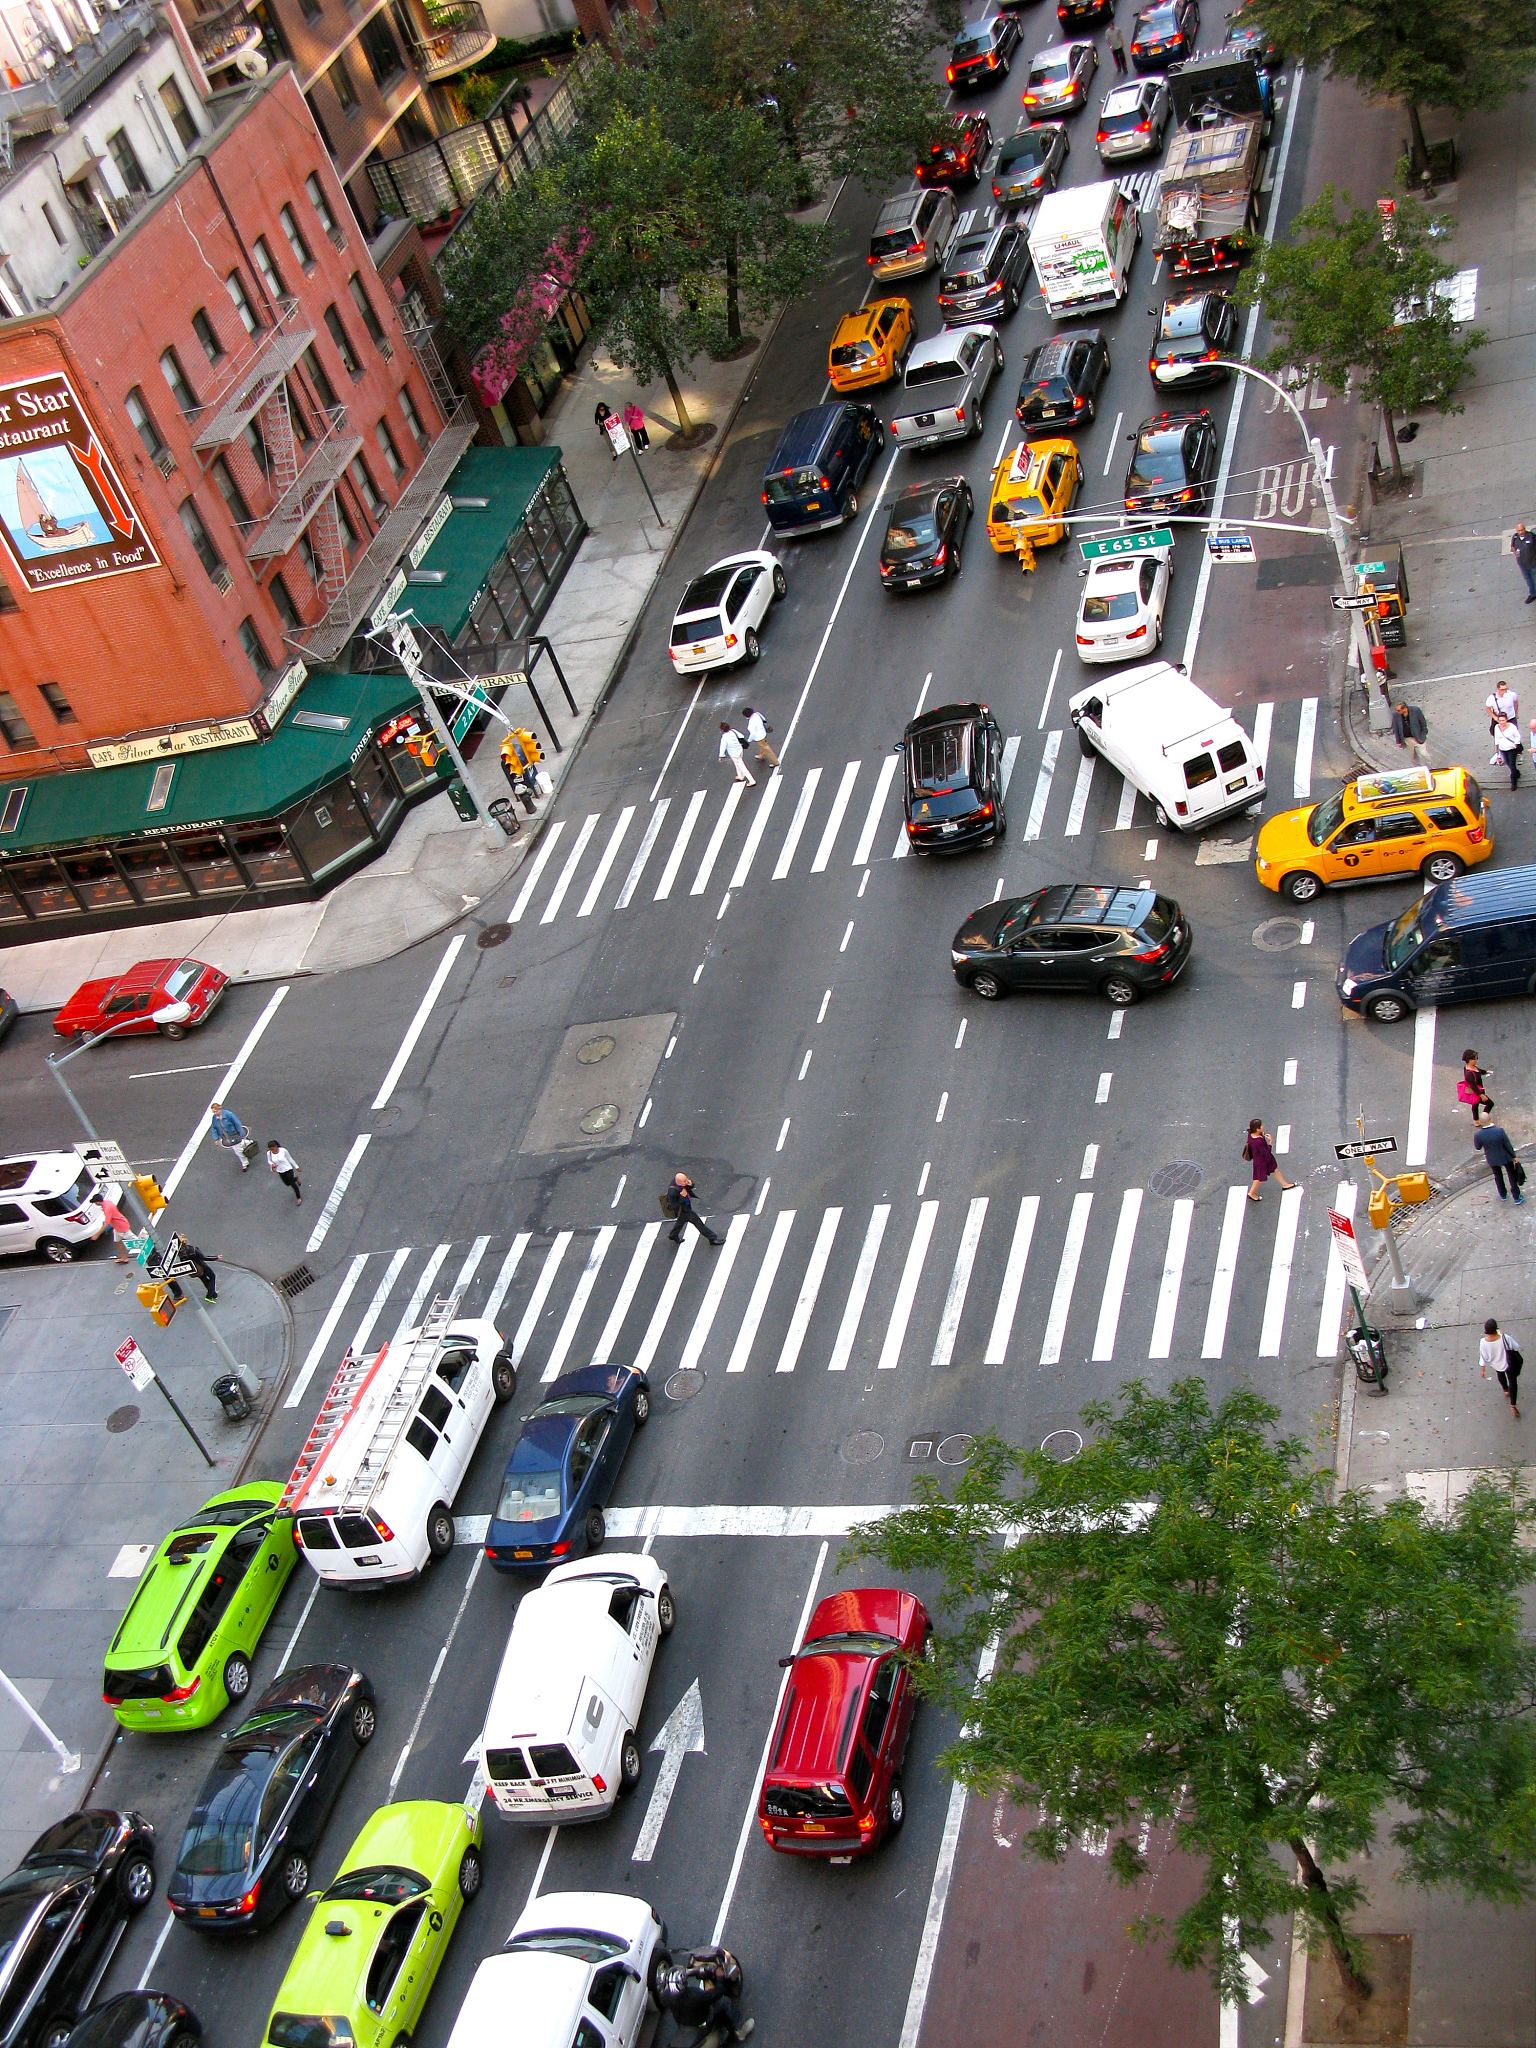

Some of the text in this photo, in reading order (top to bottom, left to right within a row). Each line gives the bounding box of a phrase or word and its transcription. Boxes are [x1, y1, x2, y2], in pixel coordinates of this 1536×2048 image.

[16, 391, 71, 418] Star
[422, 498, 454, 545] RESTAURANT
[468, 589, 482, 613] CAFÉ
[525, 468, 553, 515] RESTAURANT
[1098, 535, 1156, 554] E 65 St
[98, 553, 109, 569] in
[1363, 565, 1376, 573] 65
[436, 672, 524, 696] RESTURANT
[268, 693, 288, 723] Silver
[461, 715, 469, 728] 2
[92, 747, 115, 764] CAFÉ
[117, 745, 154, 761] Silver
[188, 725, 251, 747] RESTAURANT
[349, 727, 374, 764] DINER
[143, 819, 225, 836] RESTAURANT
[1345, 1142, 1388, 1155] ONE WAY
[124, 1241, 132, 1249] E
[154, 1265, 188, 1276] ON WAY
[559, 1773, 586, 1783] MINIMUM
[566, 1791, 593, 1801] SERVICE
